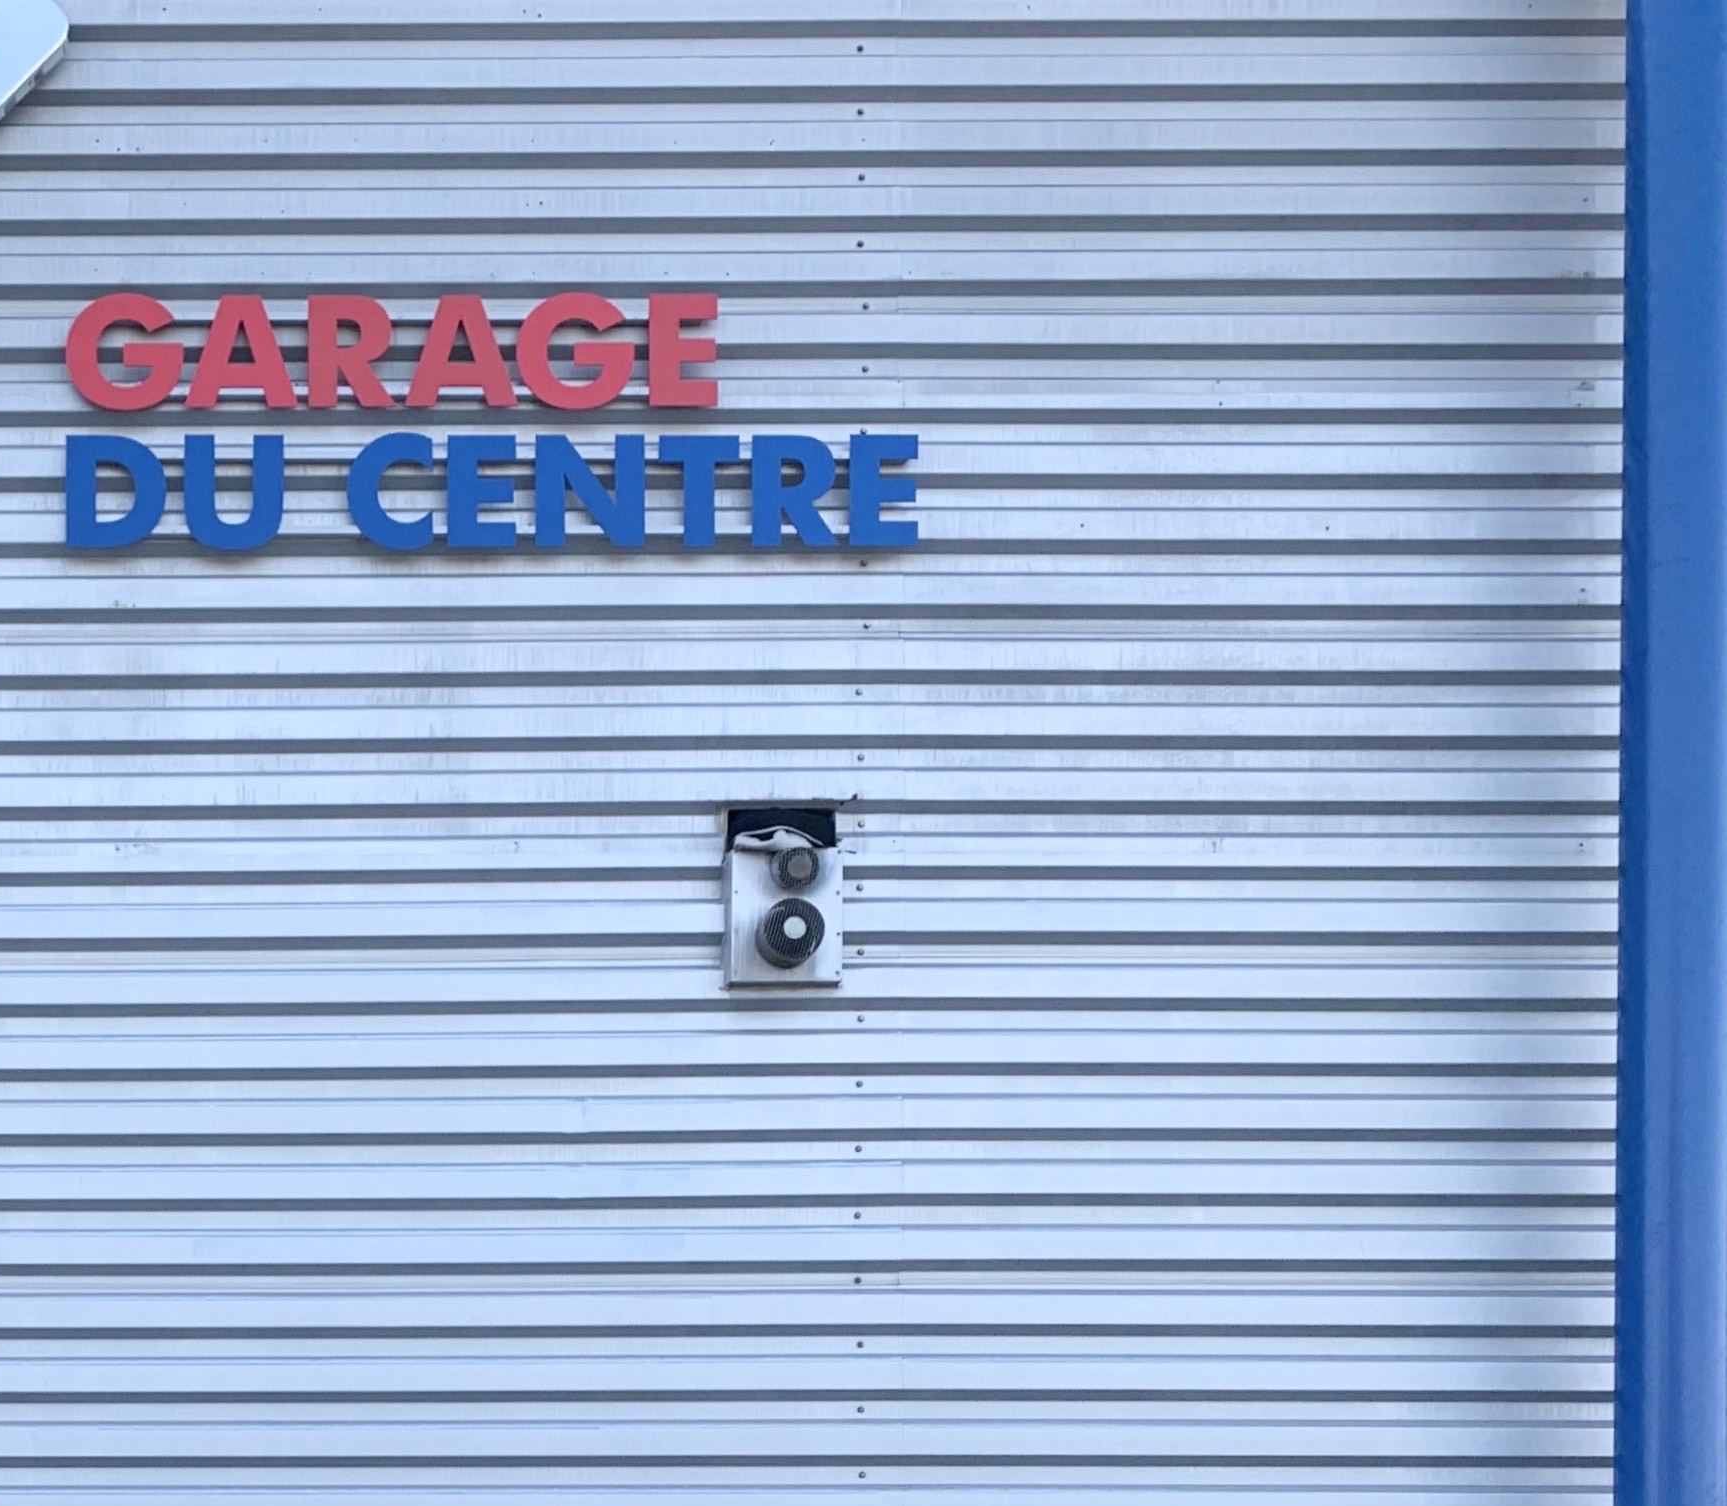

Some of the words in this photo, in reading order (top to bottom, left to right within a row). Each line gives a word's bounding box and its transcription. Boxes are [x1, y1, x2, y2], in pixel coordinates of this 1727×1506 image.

[65, 292, 719, 411] GARAGE
[65, 434, 284, 549] DU
[346, 432, 919, 549] CENTRE
